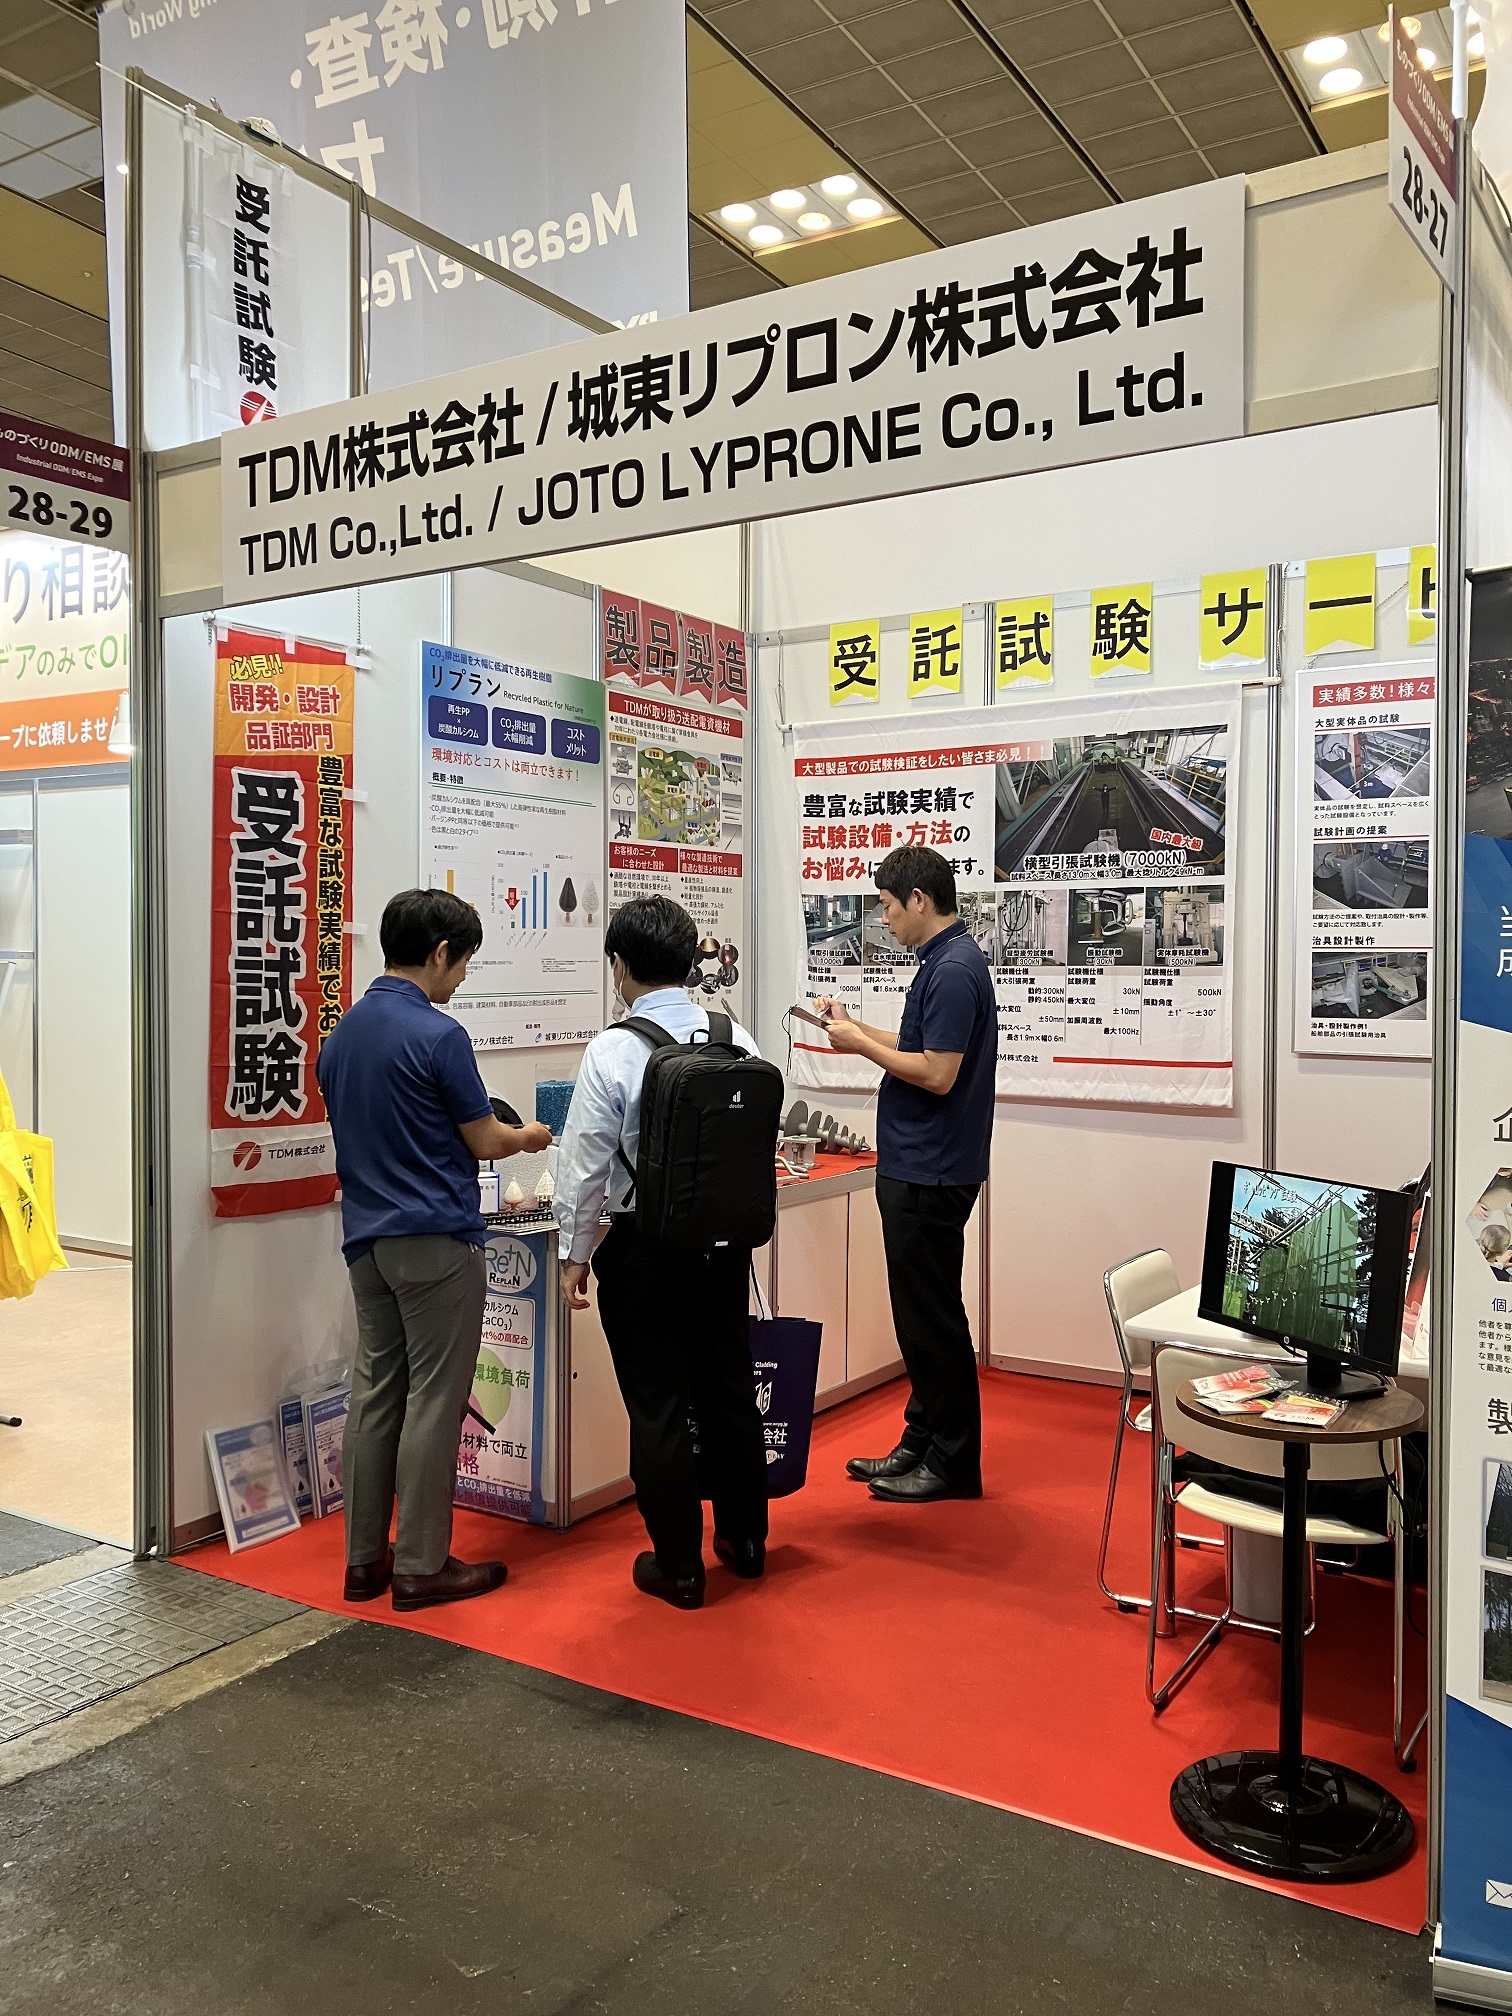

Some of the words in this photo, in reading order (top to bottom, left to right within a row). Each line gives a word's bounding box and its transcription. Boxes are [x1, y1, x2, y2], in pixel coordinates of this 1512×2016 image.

[1402, 145, 1449, 258] 28-27
[233, 174, 278, 391] 受託試験
[238, 387, 525, 507] TDM株式会社
[567, 226, 1204, 443] 城東リプロン株式会社
[0, 428, 125, 473] のづくりODM/EMS展
[239, 523, 318, 576] TDM
[518, 458, 645, 526] JOTO
[661, 401, 922, 502] LYPRONE
[941, 390, 1056, 450] Co.,
[1077, 351, 1204, 426] Ltd.
[7, 484, 113, 539] 28-29
[605, 604, 747, 695] 製品製造
[230, 654, 284, 681] 必見!!
[432, 665, 501, 698] リプラン
[1319, 681, 1435, 705] 実績多数!様々
[229, 681, 341, 715] 開発・設計
[447, 703, 471, 716] 再生PP
[503, 690, 532, 704] Recycled
[533, 696, 553, 708] Plastic
[554, 701, 564, 710] for
[564, 703, 584, 714] Nature
[624, 699, 730, 735] TDMが取り扱う送配電資機材
[1315, 713, 1400, 729] 大型実体品の試験
[246, 720, 334, 752] 品証部門
[438, 723, 479, 739] 炭酸カルシウム
[503, 731, 534, 746] 大幅削減
[567, 728, 585, 741] コスト
[565, 743, 587, 757] メリット
[803, 786, 975, 819] 豊富な試験実績で
[802, 820, 971, 850] 試験設備・方法の
[1151, 828, 1203, 851] 国内最大級
[1313, 825, 1388, 837] 試験計画の提案
[614, 846, 657, 858] お客様のニーズ
[622, 859, 665, 871] に合わせた設計
[230, 769, 304, 1118] 受託試験
[1312, 936, 1376, 945] 治具設計製作
[1122, 987, 1141, 995] 30kN
[1197, 988, 1222, 996] 500kN
[268, 1144, 326, 1160] TDM株式会社
[763, 1427, 788, 1445] 会社
